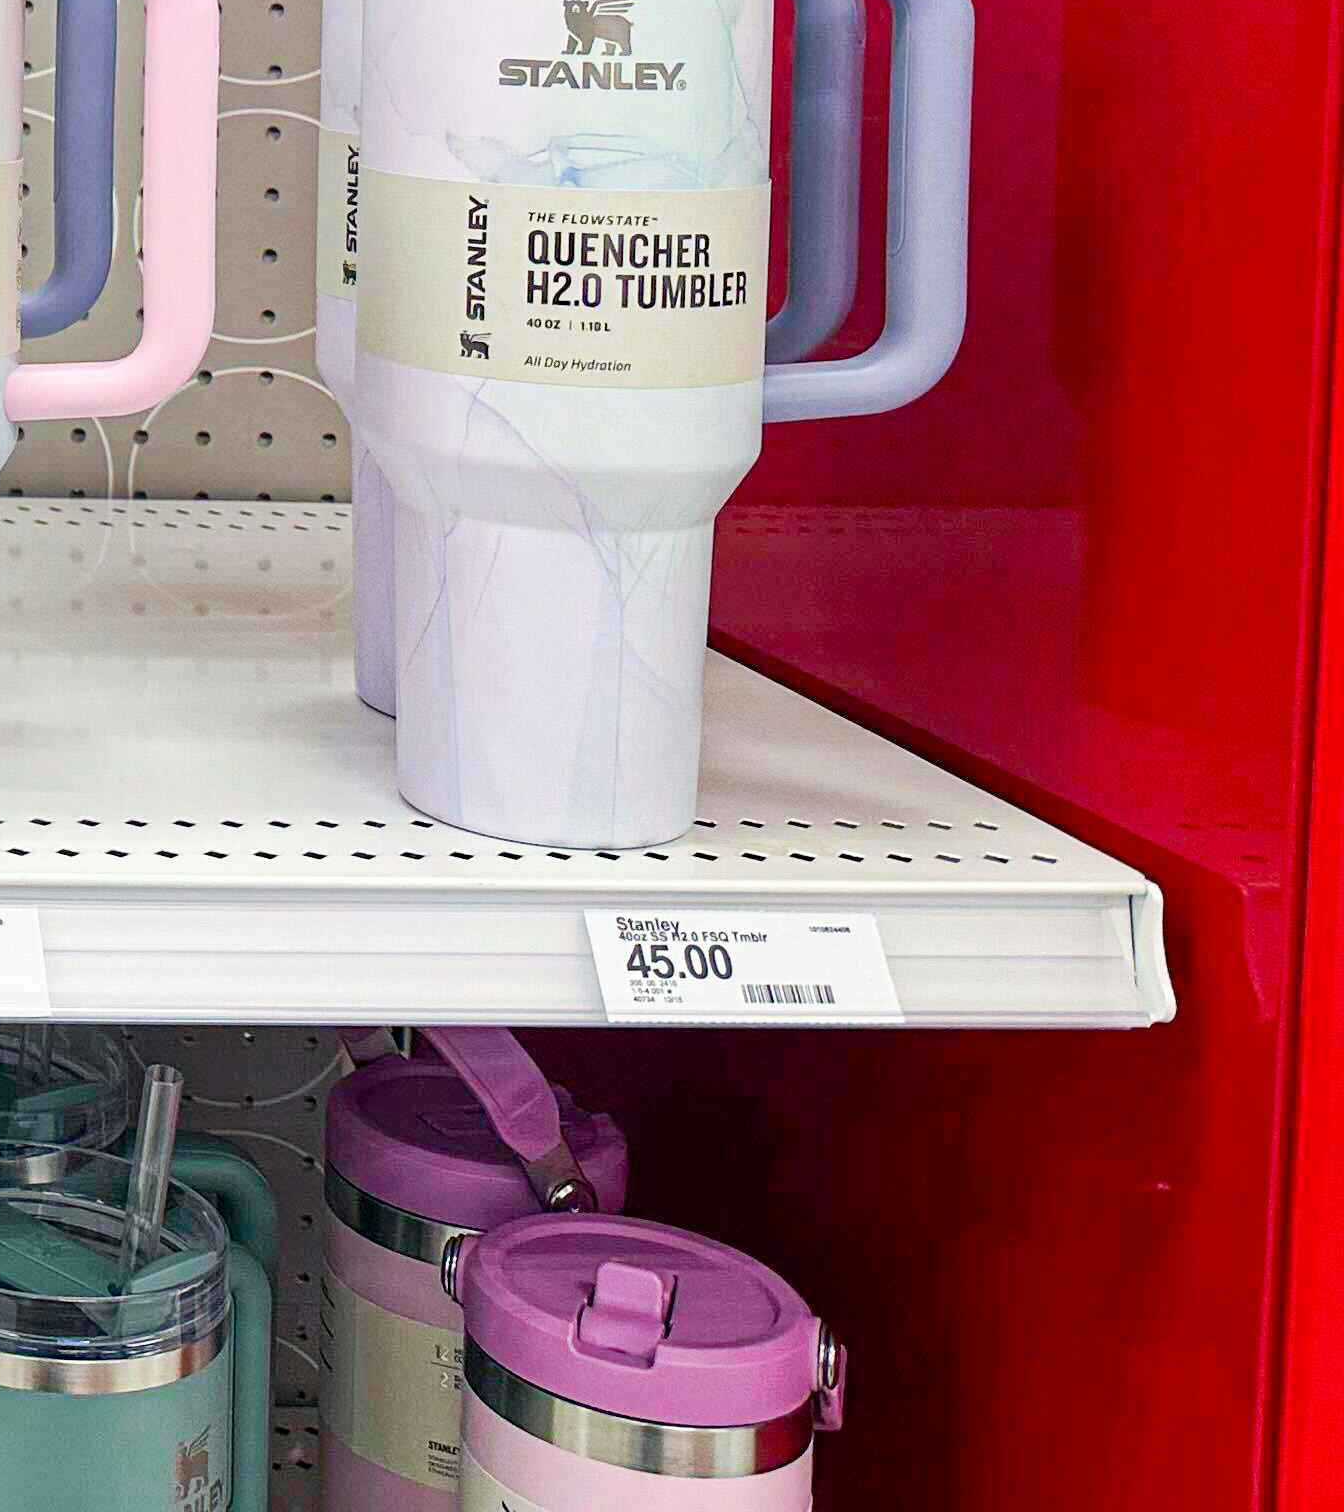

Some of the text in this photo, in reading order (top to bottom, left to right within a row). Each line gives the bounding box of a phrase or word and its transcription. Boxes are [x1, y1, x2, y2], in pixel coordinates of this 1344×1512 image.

[528, 212, 556, 225] THE
[466, 195, 488, 321] STANLEY
[528, 231, 710, 269] QUENCHER
[526, 271, 747, 309] H2.0 TUMBLER
[526, 319, 543, 329] 40
[544, 320, 561, 331] OZ
[604, 322, 611, 332] L
[524, 356, 632, 373] All Day Hydration
[616, 917, 680, 934] Stanley
[619, 932, 648, 942] 40oz
[651, 932, 668, 942] SS
[702, 932, 729, 943] FSQ
[733, 932, 768, 942] Tmblr
[627, 944, 733, 979] 45.00
